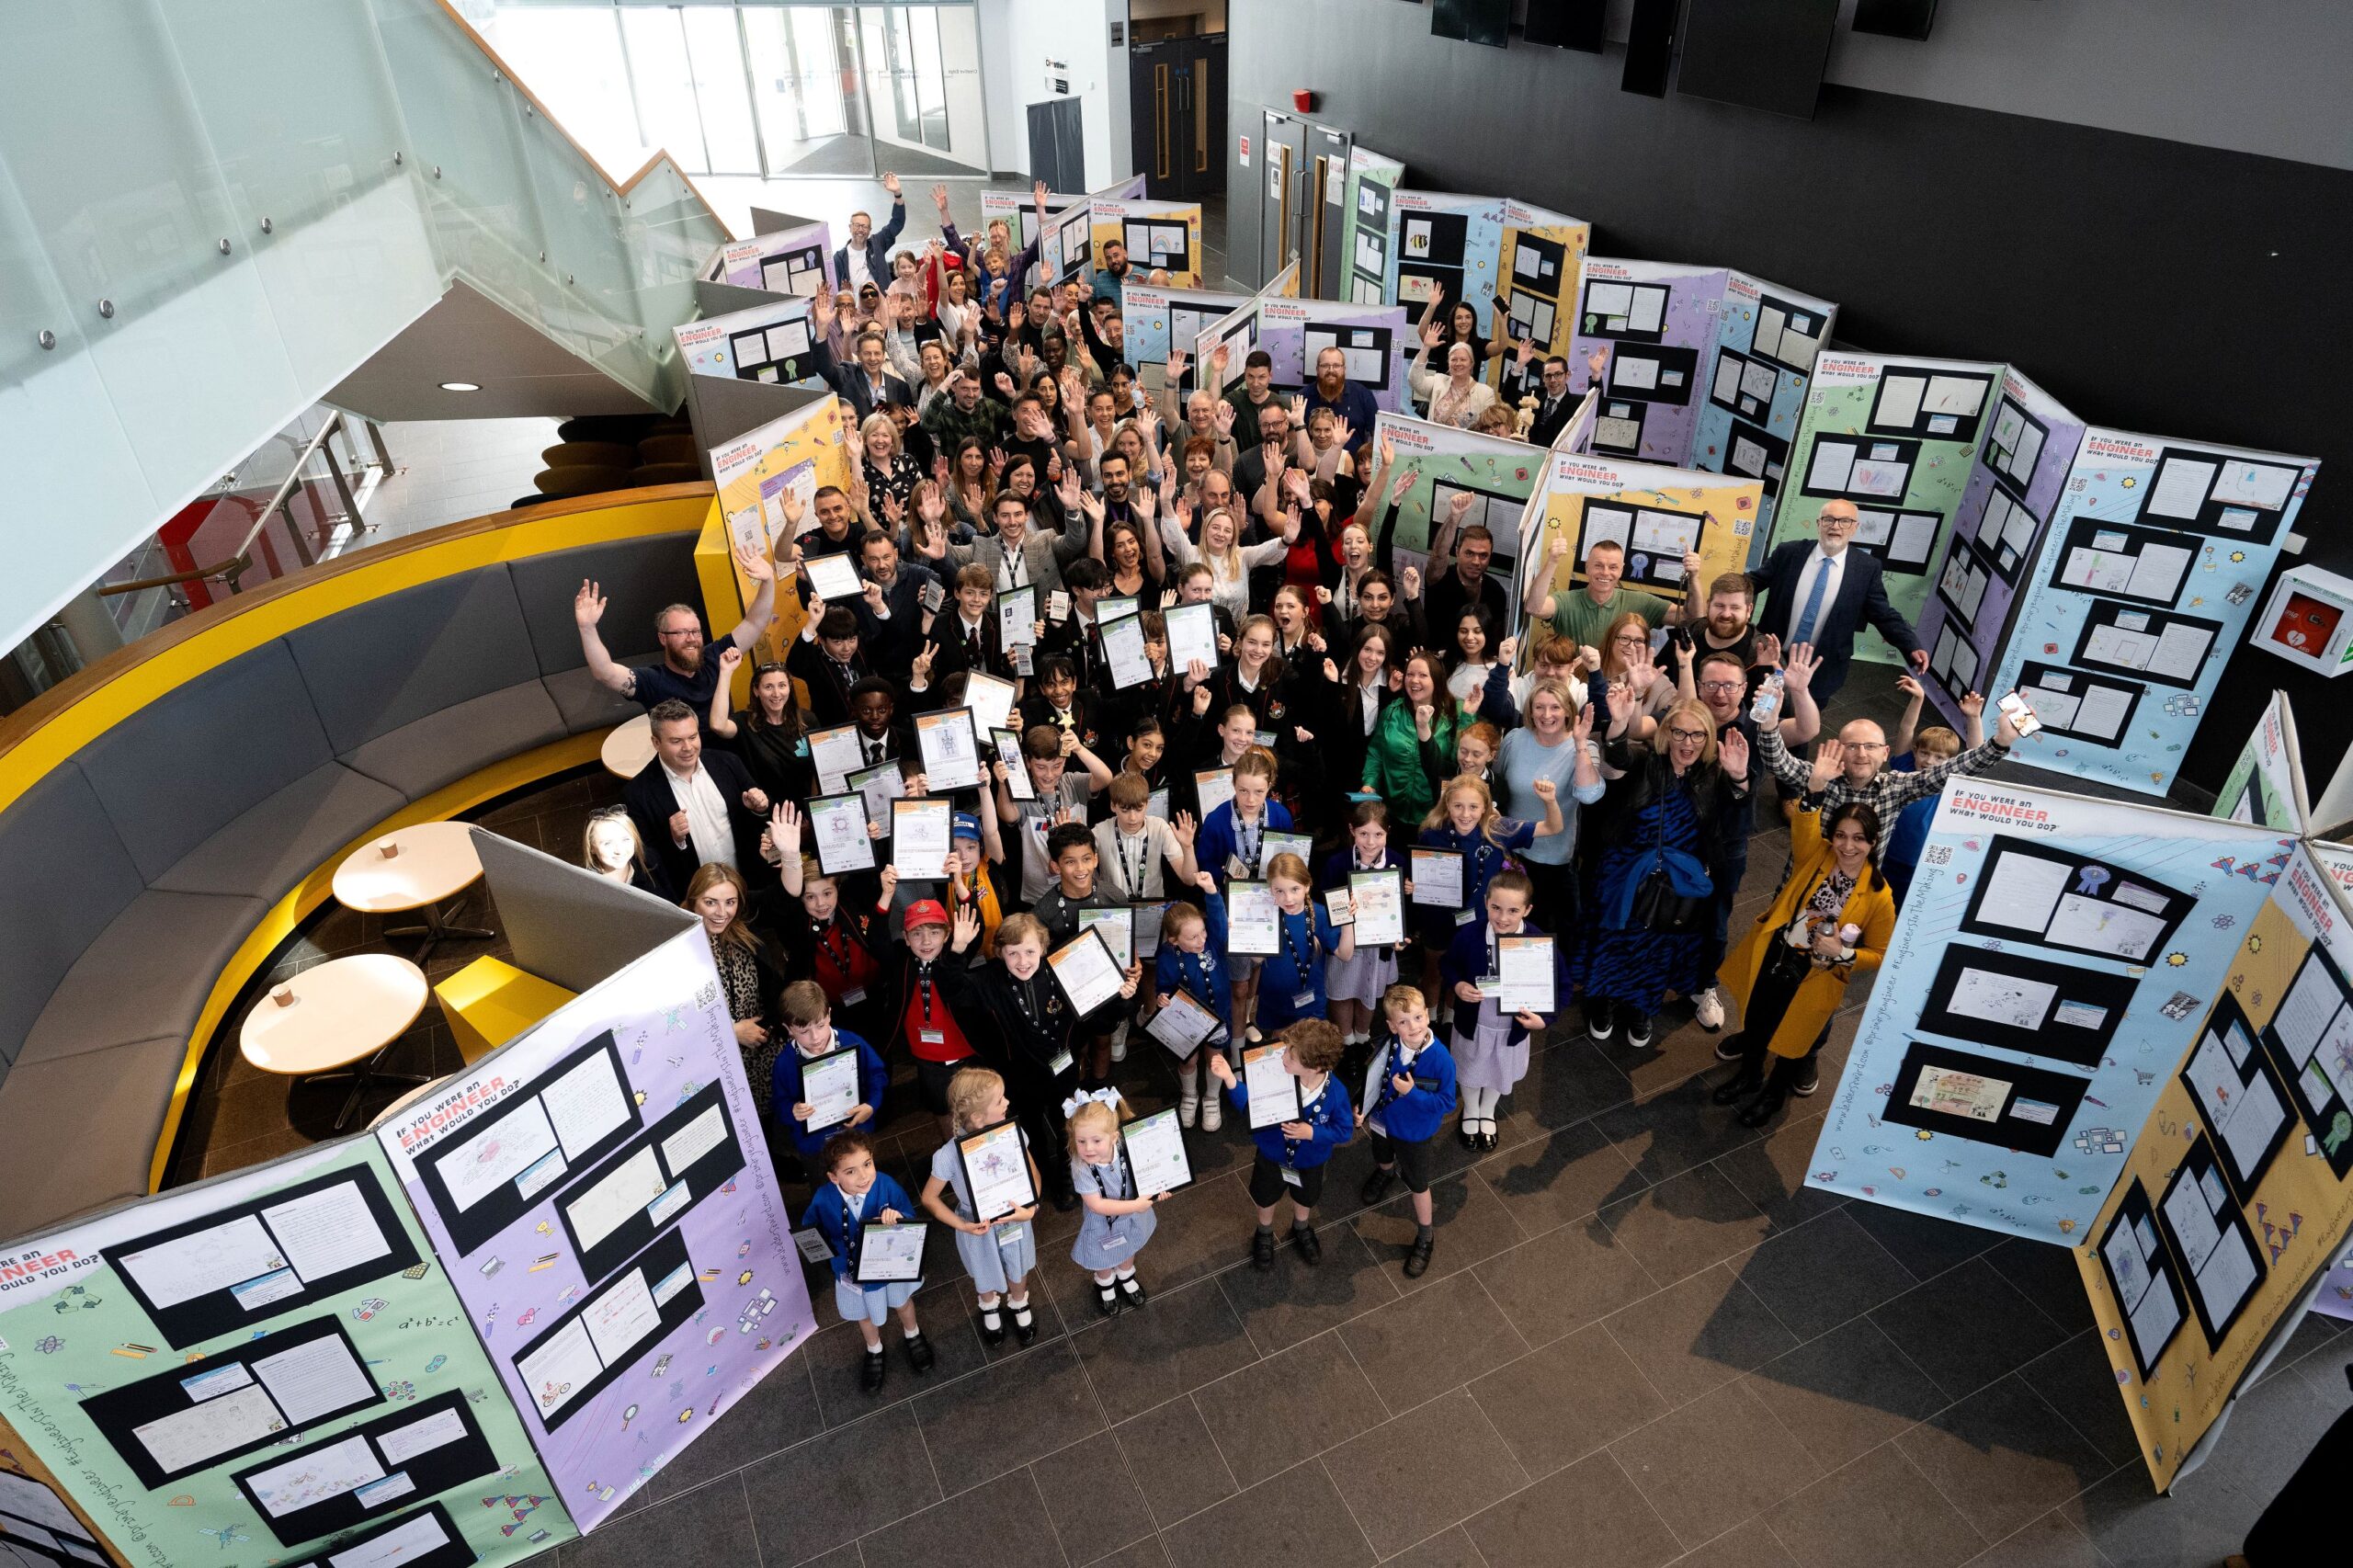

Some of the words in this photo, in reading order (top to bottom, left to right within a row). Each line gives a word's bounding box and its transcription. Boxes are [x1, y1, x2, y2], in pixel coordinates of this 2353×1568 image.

[1587, 267, 1627, 276] ENGINEER
[1128, 296, 1165, 305] ENGINEER
[1265, 308, 1306, 316] ENGINEER
[680, 328, 722, 343] ENGINEER
[1823, 364, 1874, 373] ENGINEER
[1381, 427, 1428, 444] ENGINEER
[717, 444, 756, 469] ENGINEER
[2088, 442, 2153, 457] ENGINEER
[1560, 467, 1617, 481] ENGINEER
[1969, 792, 1986, 801] YOU
[1991, 796, 2015, 805] WERE
[1952, 798, 2049, 822] ENGINEER
[1980, 813, 2011, 824] WOULD
[2037, 824, 2057, 832] DO?
[2302, 868, 2312, 881] YOU
[2311, 881, 2323, 900] WERE
[2291, 868, 2333, 933] ENGINEER
[2299, 897, 2313, 920] WOULD
[2312, 920, 2321, 933] YOU
[2321, 932, 2332, 947] DO?
[1864, 975, 1897, 1045] @primaryengineer
[396, 1128, 406, 1138] IF
[411, 1112, 432, 1128] YOU
[436, 1093, 462, 1112] WERE
[466, 1082, 480, 1093] an
[401, 1076, 505, 1148] ENGINEER
[439, 1108, 473, 1135] WOULD
[478, 1095, 497, 1109] YOU
[501, 1080, 519, 1096] DO?
[22, 1251, 40, 1261] an
[0, 1276, 35, 1291] OULD
[40, 1266, 67, 1278] YOU
[73, 1255, 98, 1268] DO?
[81, 1470, 153, 1542] @primaryengineer
